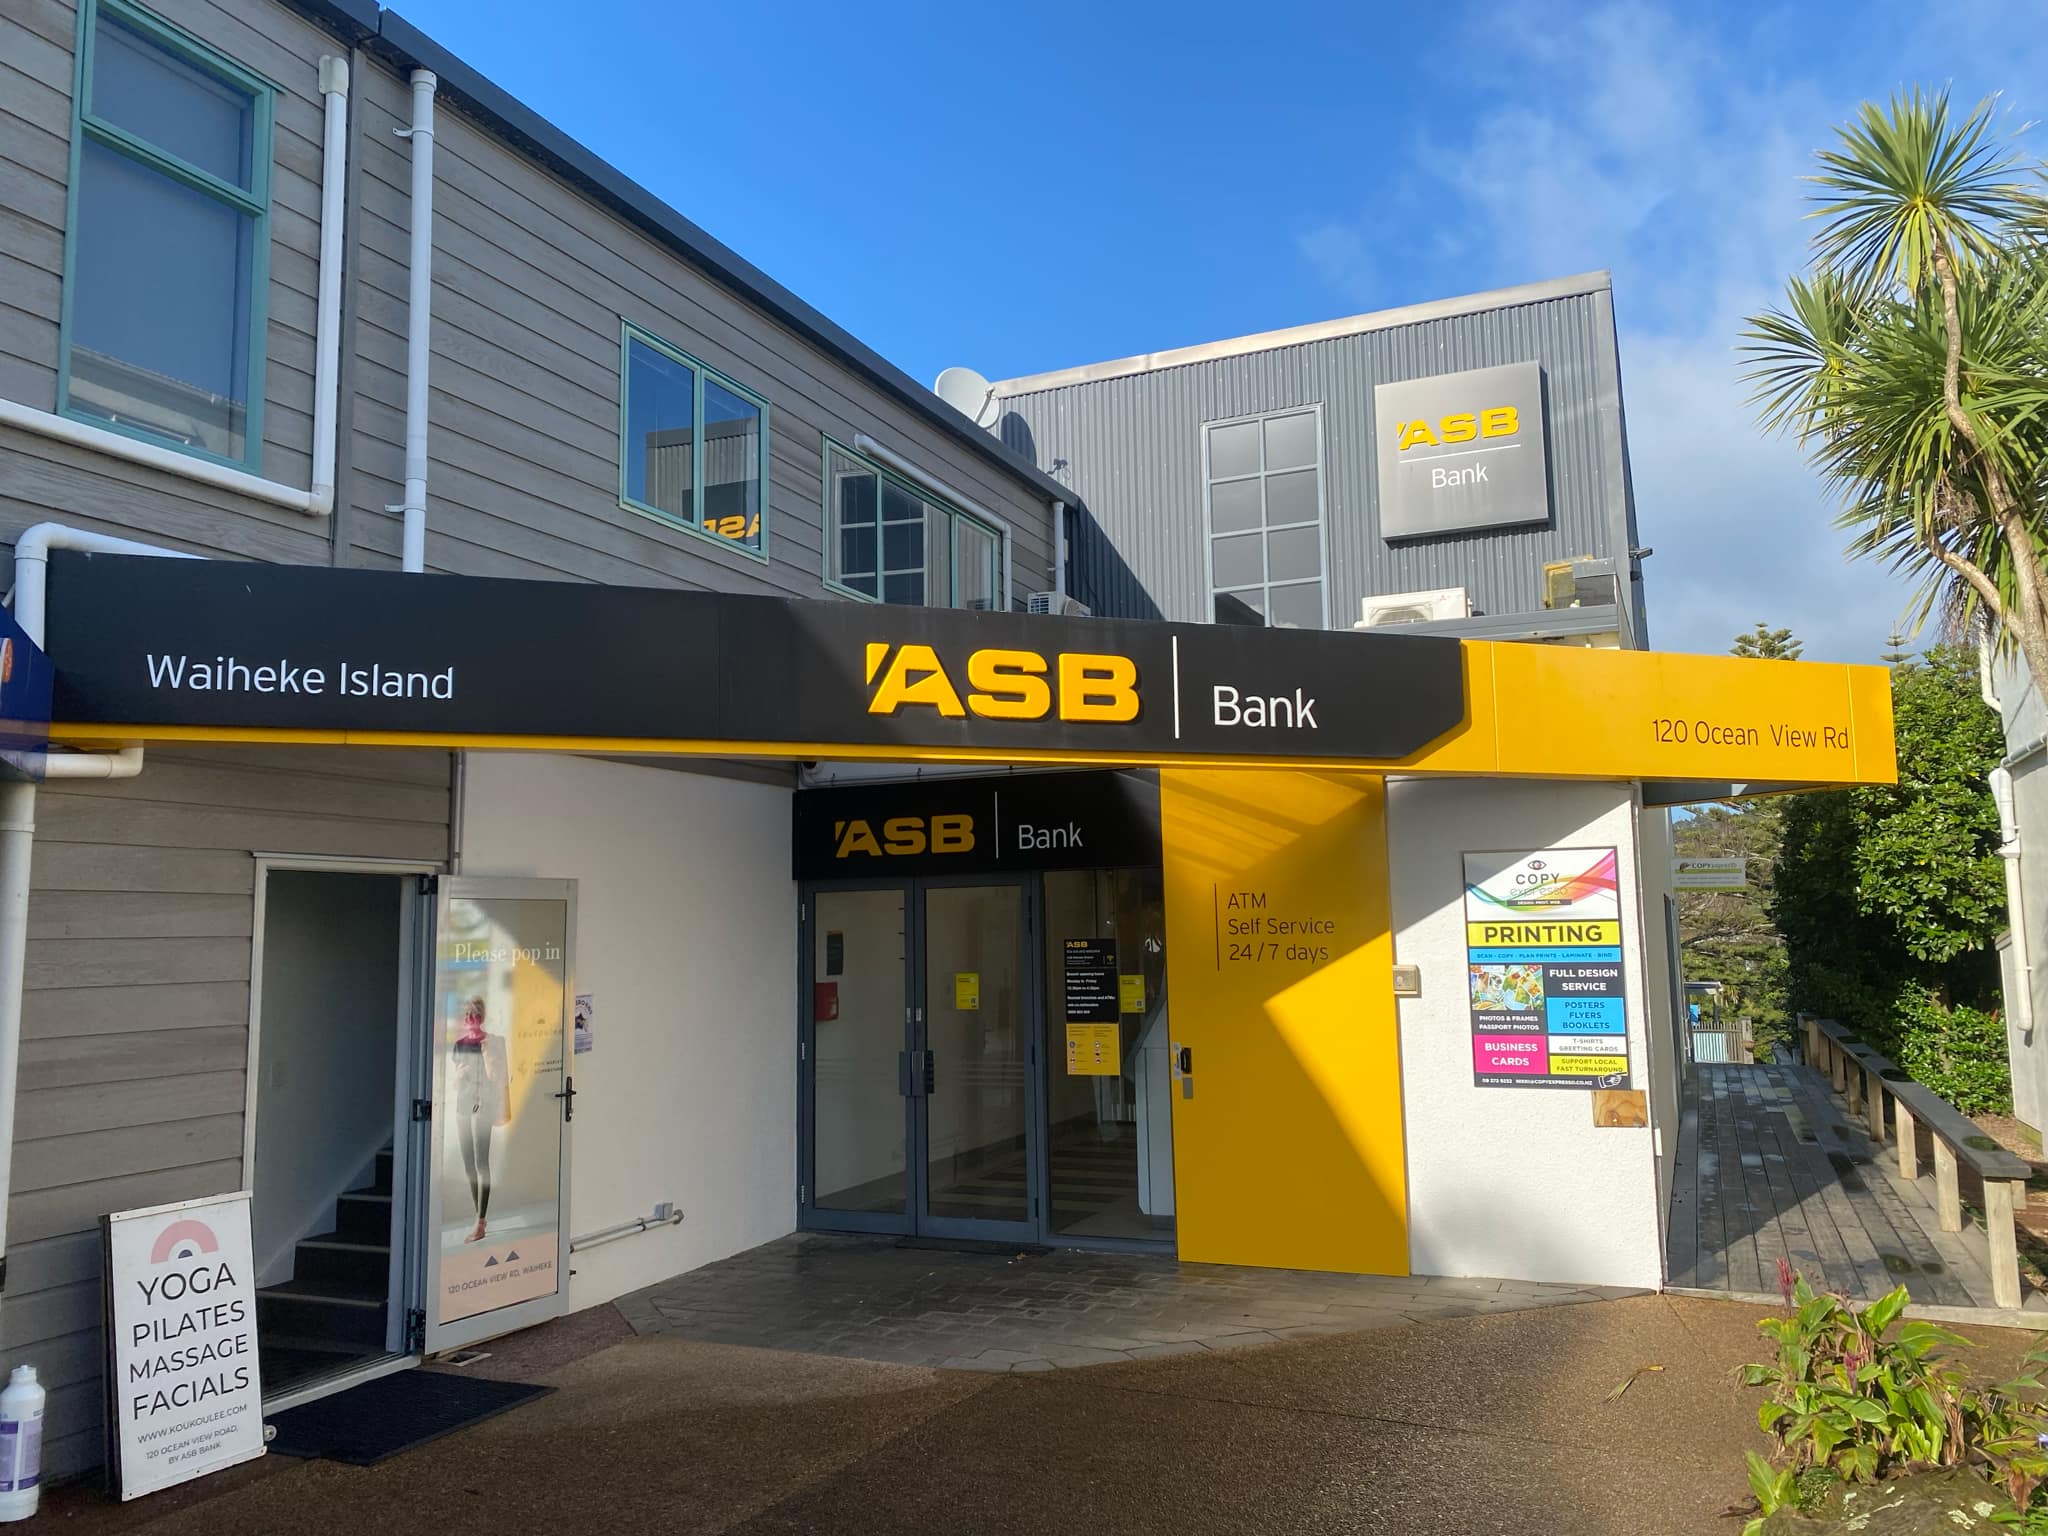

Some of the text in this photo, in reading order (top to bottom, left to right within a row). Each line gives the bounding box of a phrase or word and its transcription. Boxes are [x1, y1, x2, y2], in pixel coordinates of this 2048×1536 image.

[1396, 405, 1521, 450] ASB
[1431, 462, 1489, 489] Bank
[146, 654, 454, 700] Waiheke Island
[866, 642, 1318, 729] ASB Bank
[1652, 718, 1849, 749] 120 Ocean View Rd
[834, 813, 1084, 858] ASB Bank
[1515, 873, 1560, 885] COPY
[1227, 892, 1267, 910] ATM
[1510, 886, 1569, 898] expresso
[1228, 917, 1335, 936] Self Service
[1484, 925, 1603, 943] PRINTING
[454, 941, 560, 968] Please pop in
[1286, 943, 1329, 965] days
[1549, 969, 1618, 978] FULL DESIGN
[1561, 982, 1607, 991] SERVICE
[1564, 1001, 1605, 1009] POSTERS
[1569, 1011, 1602, 1019] FLYERS
[1562, 1021, 1610, 1029] BOOKLETS
[1484, 1042, 1539, 1052] BUSINESS
[1491, 1057, 1530, 1066] CARDS
[137, 1261, 237, 1306] YOGA
[447, 1283, 461, 1294] 120
[461, 1277, 488, 1291] OCEAN
[489, 1272, 508, 1283] VIEW
[522, 1260, 553, 1275] WAIHEKE
[132, 1300, 246, 1348] PILATES
[130, 1333, 249, 1384] MASSAGE
[133, 1366, 250, 1420] FACIALS
[137, 1403, 248, 1444] WWW.KOUKOULEE.COM
[146, 1449, 160, 1460] 120
[160, 1439, 191, 1455] OCEAN
[191, 1431, 214, 1445] VIEW
[168, 1441, 222, 1465] BY ASB BANK
